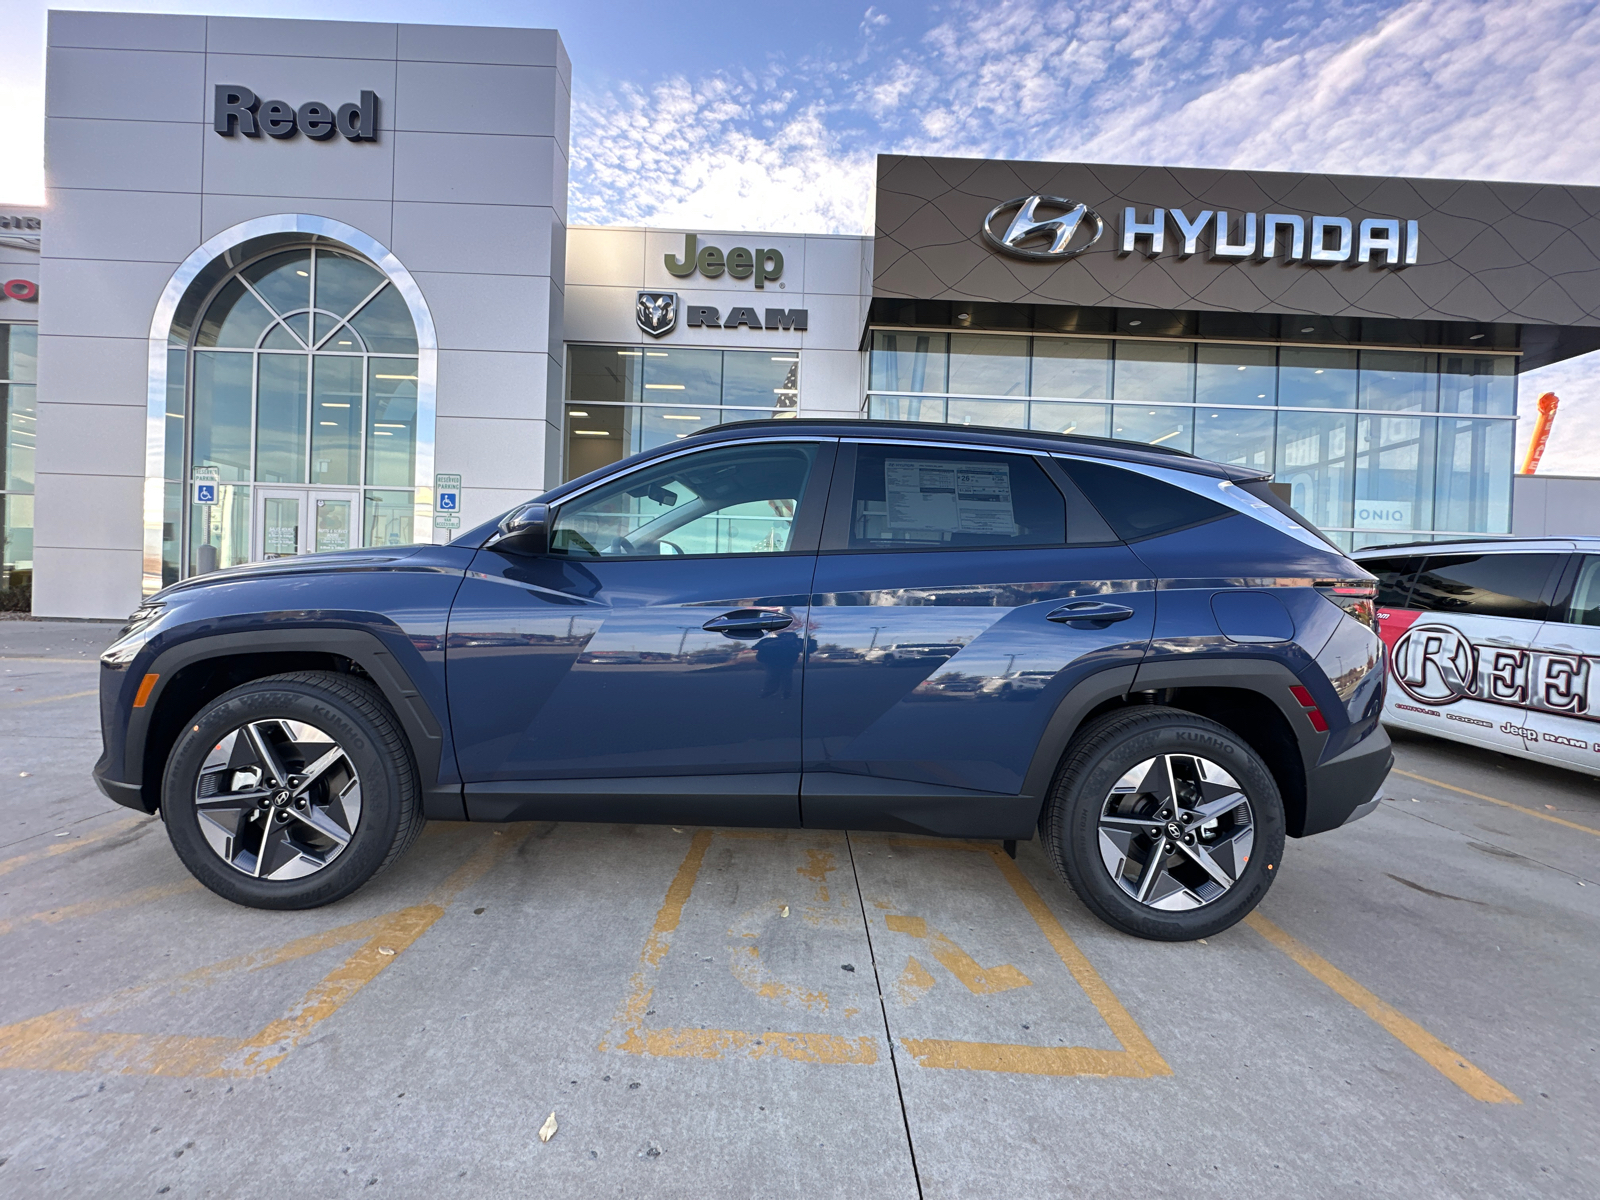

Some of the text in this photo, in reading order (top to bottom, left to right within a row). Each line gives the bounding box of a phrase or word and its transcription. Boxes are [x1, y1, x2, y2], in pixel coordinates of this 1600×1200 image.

[214, 84, 379, 142] Reed
[664, 234, 784, 289] Jeep
[1119, 207, 1418, 267] HYUNDAI
[687, 305, 809, 331] RAM
[1391, 623, 1600, 724] REE
[312, 704, 365, 750] KUMHO
[1176, 731, 1235, 755] KUMHO
[1446, 713, 1493, 728] DODGE
[1500, 722, 1538, 742] Jeep
[1543, 733, 1587, 749] RAM
